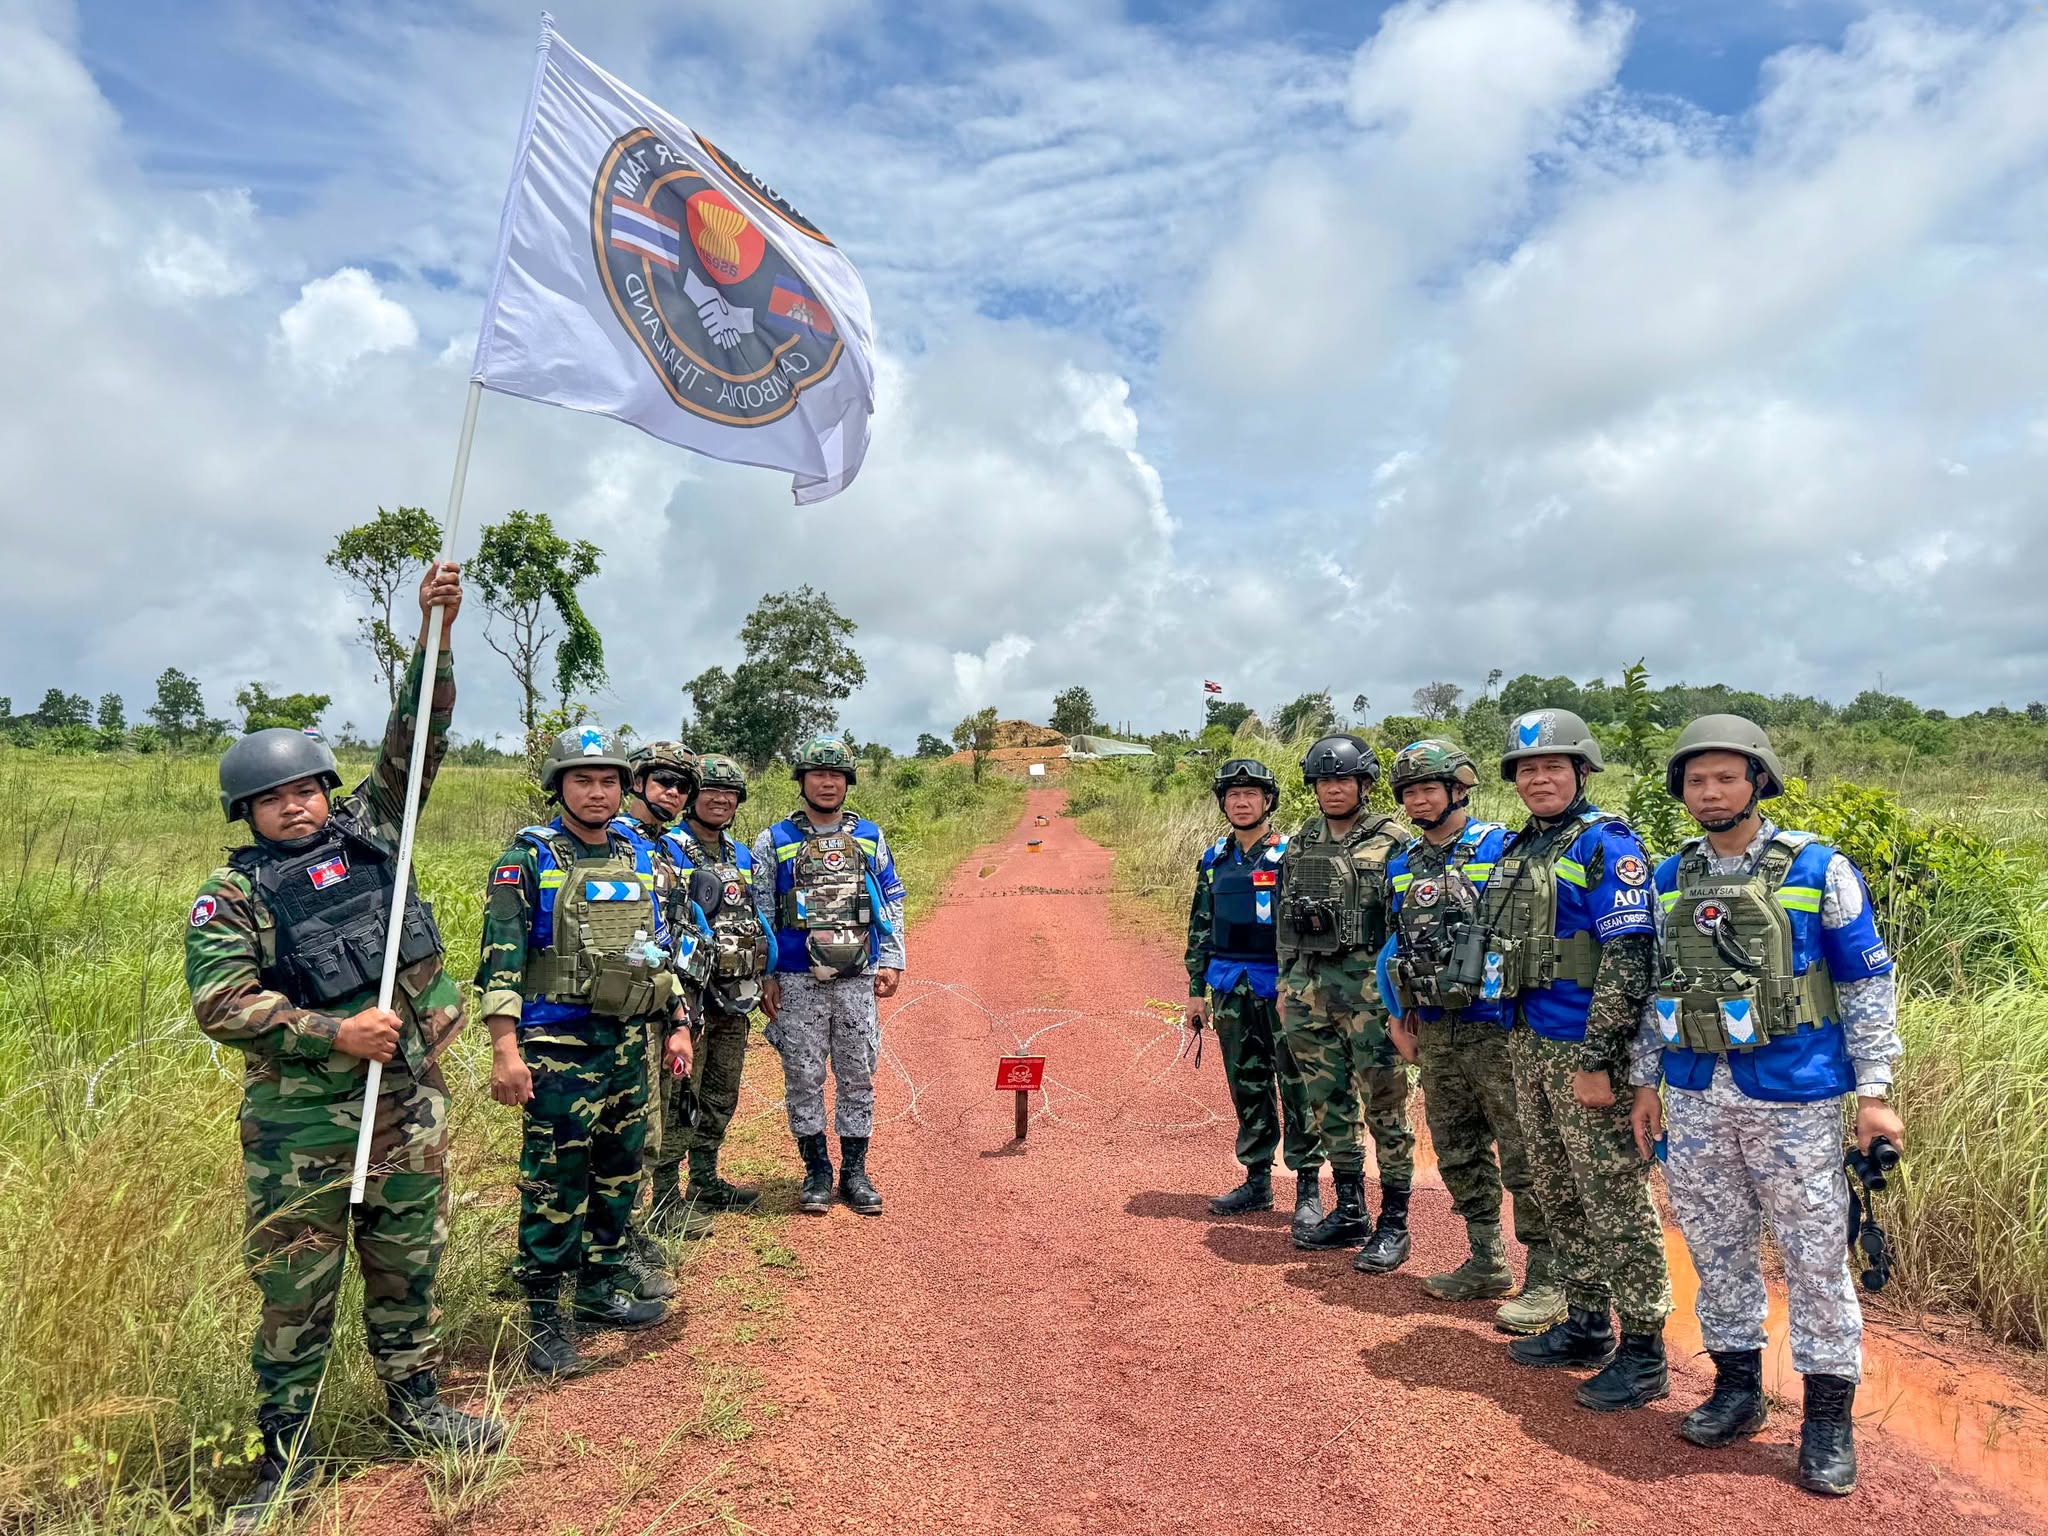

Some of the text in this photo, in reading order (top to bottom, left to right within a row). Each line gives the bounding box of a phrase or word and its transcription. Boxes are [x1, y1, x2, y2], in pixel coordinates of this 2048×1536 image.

[1613, 888, 1650, 908] AOT
[1689, 887, 1735, 897] MALAYSIA
[1600, 915, 1623, 933] ASEAN
